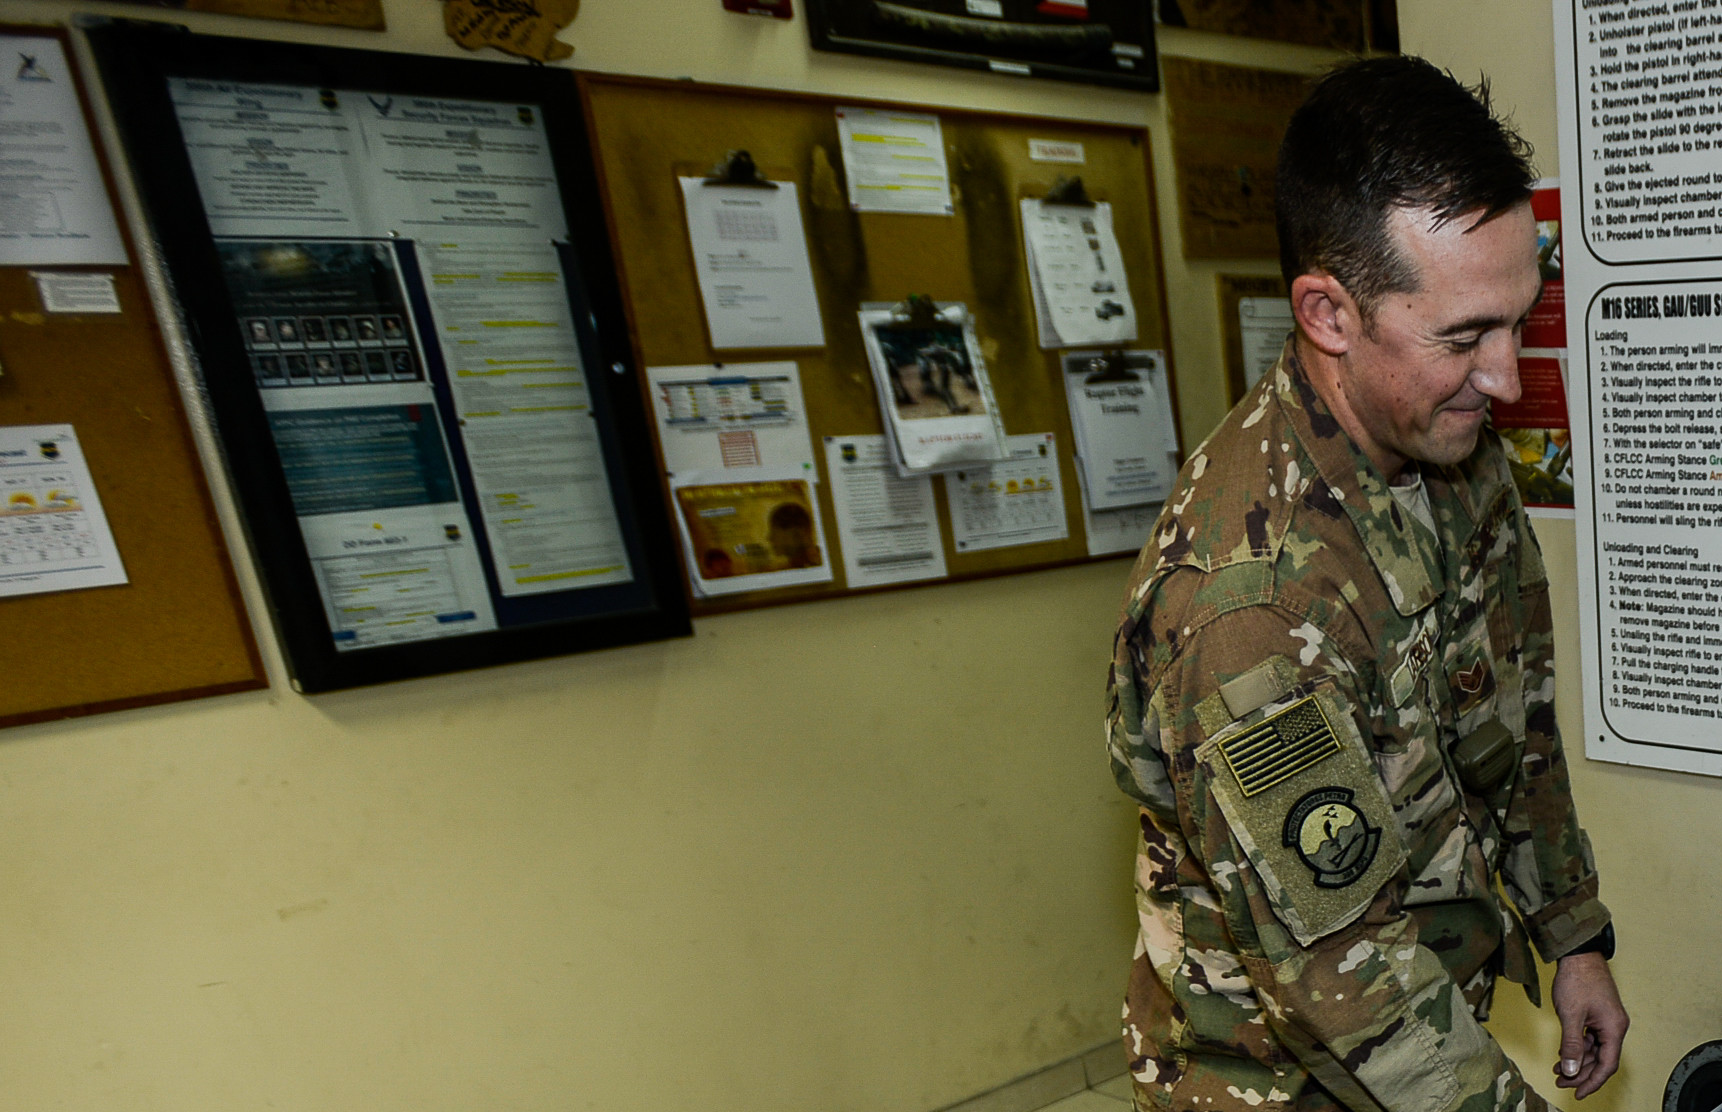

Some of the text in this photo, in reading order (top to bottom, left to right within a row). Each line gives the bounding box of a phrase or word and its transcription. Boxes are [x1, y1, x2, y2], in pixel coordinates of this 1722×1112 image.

[1588, 64, 1598, 78] 3.
[1599, 60, 1622, 76] Hold
[1623, 59, 1640, 73] the
[1640, 54, 1669, 73] pistol
[1670, 53, 1681, 67] in
[1603, 292, 1622, 320] M16
[1623, 294, 1662, 320] SERIES,
[1662, 292, 1712, 318] GAU/GUU
[1593, 328, 1628, 343] Loading
[1600, 376, 1609, 388] 3.
[1609, 375, 1643, 390] Visually
[1644, 375, 1676, 389] inspect
[1677, 374, 1692, 387] the
[1693, 374, 1711, 387] rifle
[1712, 375, 1722, 387] to
[1603, 452, 1612, 464] 8.
[1612, 451, 1643, 464] CFLCC
[1644, 452, 1675, 468] Arming
[1676, 452, 1707, 466] Stance
[1602, 540, 1699, 559] Unloading and Clearing
